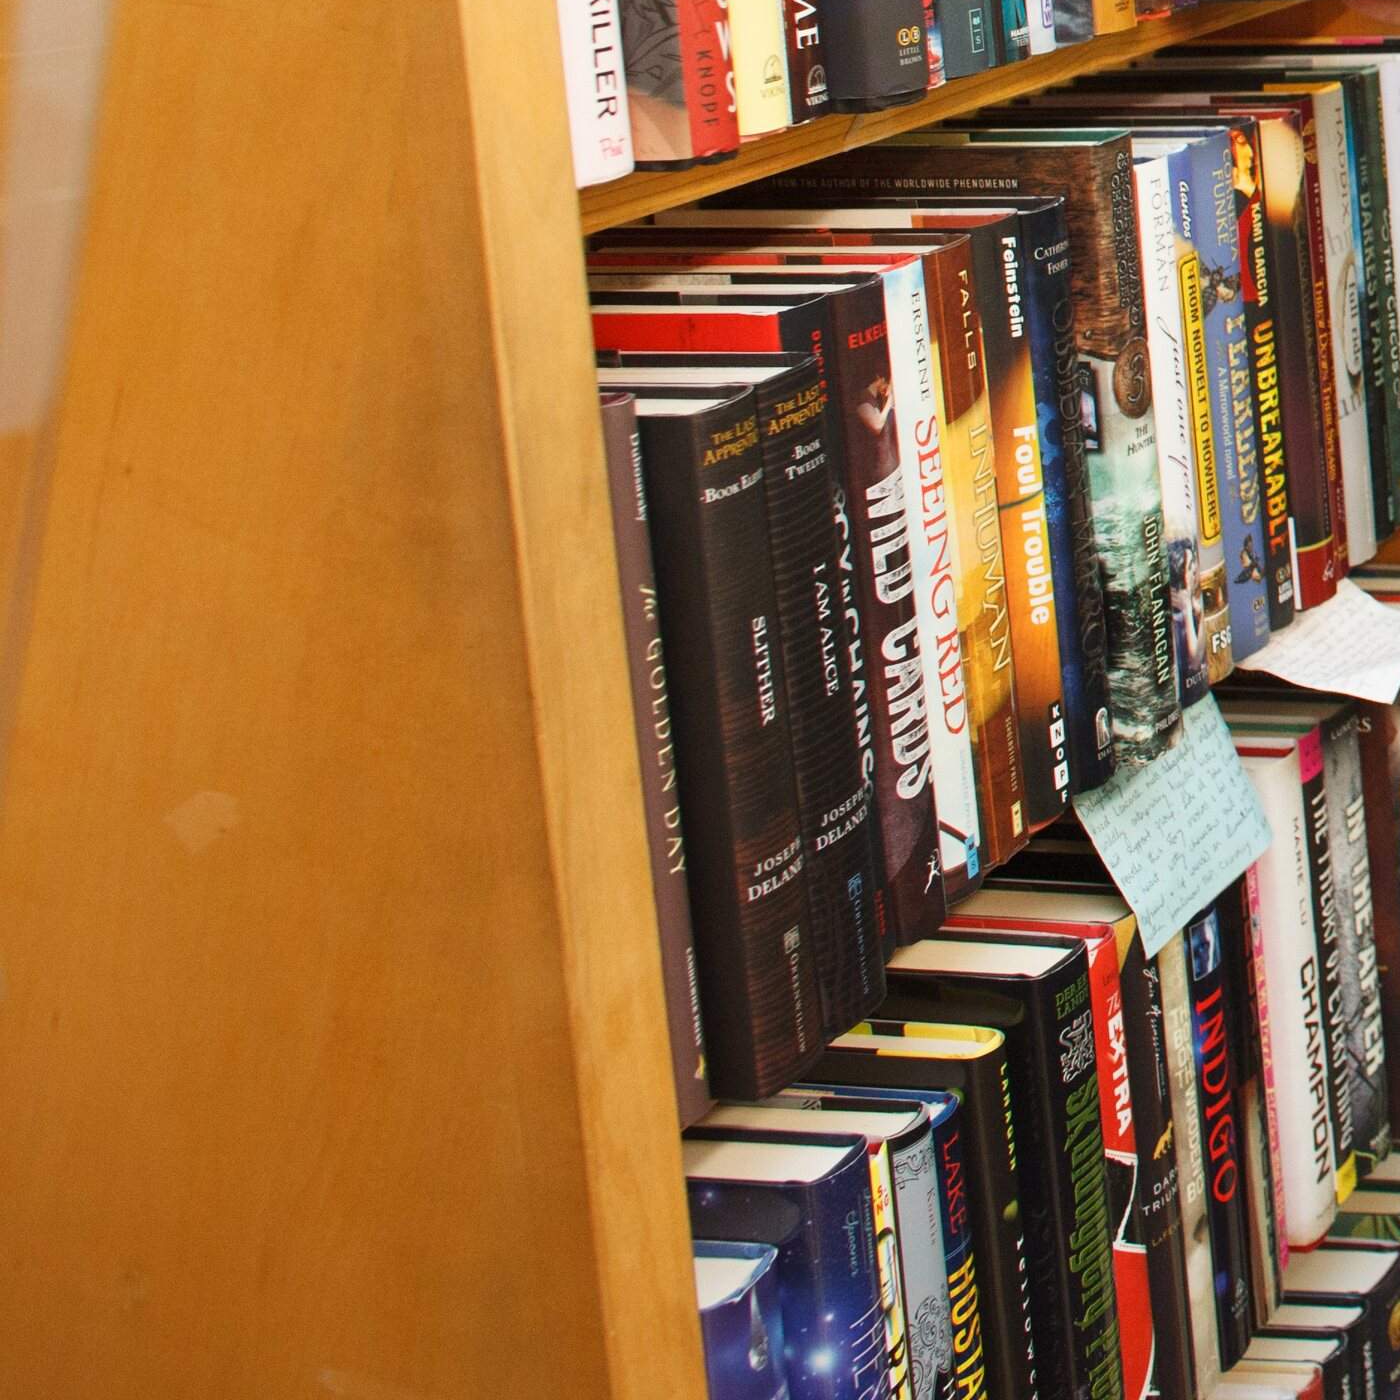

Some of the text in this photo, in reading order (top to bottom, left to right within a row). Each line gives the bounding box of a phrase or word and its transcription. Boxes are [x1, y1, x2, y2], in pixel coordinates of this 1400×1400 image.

[696, 47, 719, 128] KNOPF
[893, 178, 1019, 190] WORLDWIDE PHENOMENON
[1178, 179, 1193, 239] Gantos
[1212, 167, 1229, 247] FUNKE
[1250, 201, 1269, 307] KAMI GARCIA
[1001, 236, 1051, 626] Feinstein Foul Trouble
[1187, 273, 1218, 523] FROM NORVELT TO NOWHERE
[1218, 378, 1233, 446] Mirrorworld
[1252, 318, 1289, 555] UNBREAKABLE
[911, 290, 967, 735] ERSKINE SEEING RED
[956, 268, 1011, 672] FALLS INHUMAN
[1225, 448, 1237, 481] novel
[813, 563, 840, 698] I AM ALICE
[865, 464, 933, 801] WILD CARDS
[1143, 515, 1171, 685] JOHN FLANAGAN
[752, 615, 776, 727] SLITHER
[645, 637, 687, 875] GOLDEN DAY
[819, 788, 865, 827] JOSEPH
[815, 805, 869, 852] DELANEY
[1345, 794, 1387, 1078] IN THE AFTER
[1106, 1017, 1136, 1138] EXTRA
[1196, 986, 1239, 1205] INDIGO
[1298, 955, 1333, 1185] CHAMPION
[942, 1132, 968, 1235] LAKE
